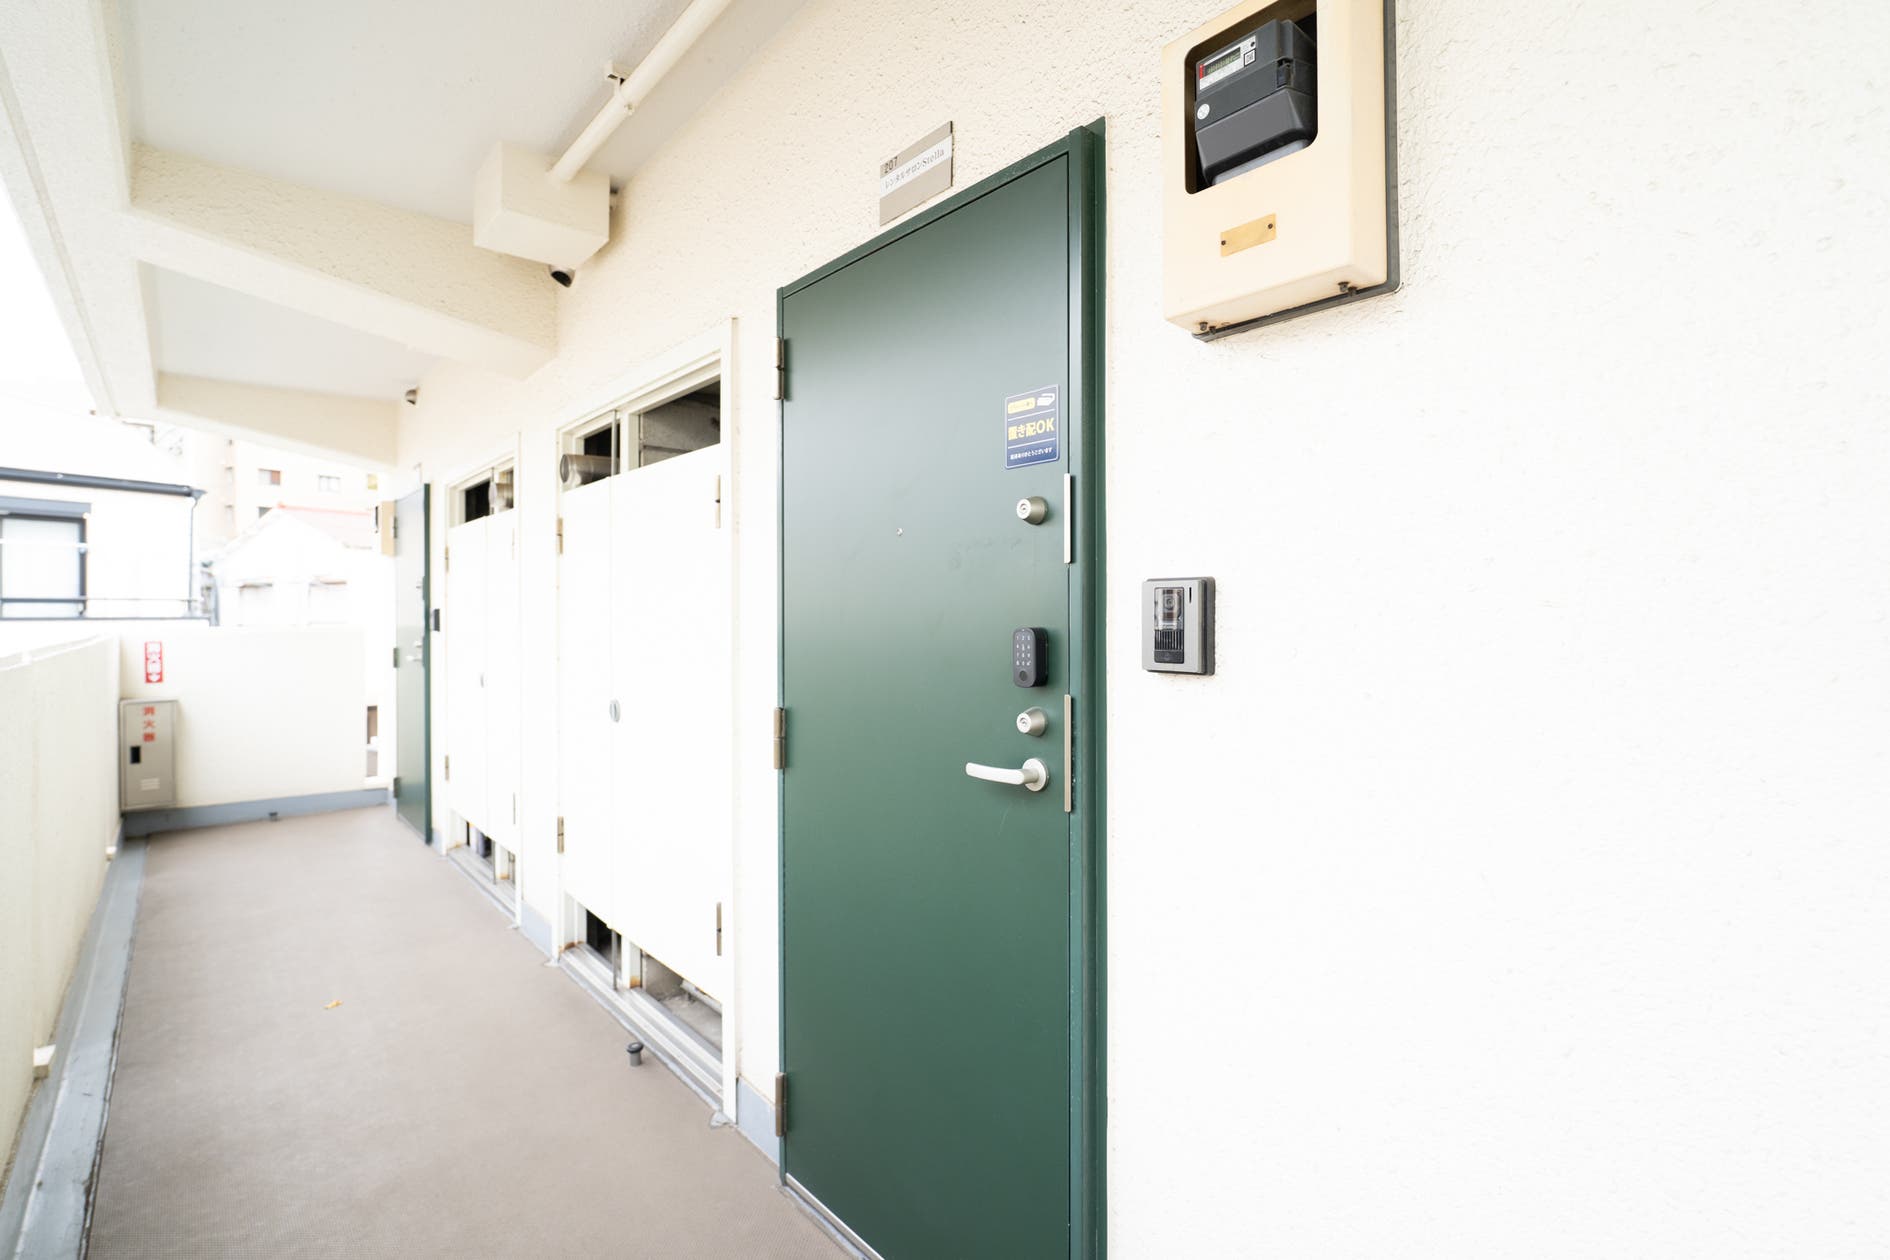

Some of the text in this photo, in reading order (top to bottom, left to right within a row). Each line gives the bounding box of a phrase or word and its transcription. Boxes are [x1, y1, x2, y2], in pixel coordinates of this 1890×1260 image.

[884, 156, 898, 174] 207
[143, 706, 156, 742] 消火器
